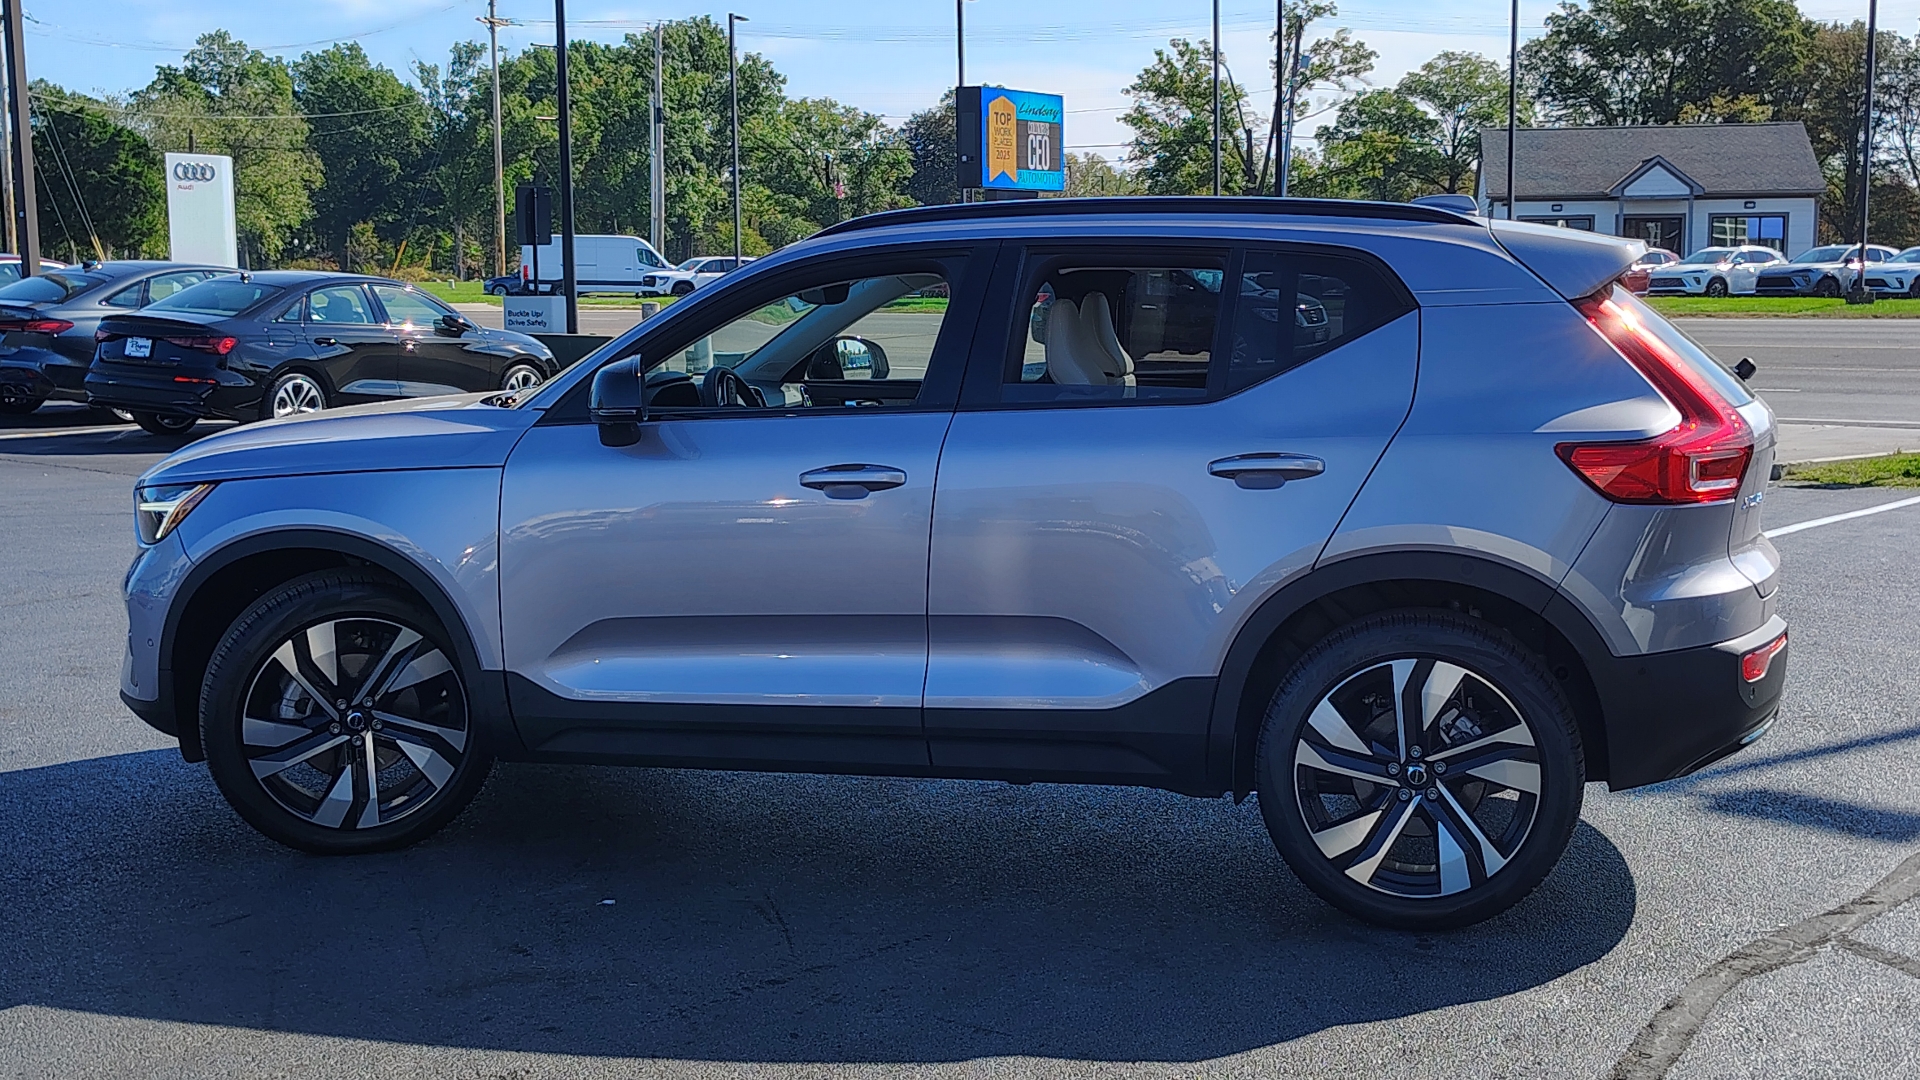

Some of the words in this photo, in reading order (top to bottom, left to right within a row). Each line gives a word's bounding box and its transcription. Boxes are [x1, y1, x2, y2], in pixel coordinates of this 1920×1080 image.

[1018, 102, 1061, 121] Lindsay
[993, 111, 1012, 126] TOP
[993, 126, 1013, 137] WORK
[993, 136, 1013, 147] PLACES
[996, 149, 1011, 160] 2025
[1027, 134, 1050, 171] CEO
[1017, 172, 1062, 185] AUTOMOTIVE
[507, 309, 530, 318] Buckle
[526, 319, 547, 328] Safely
